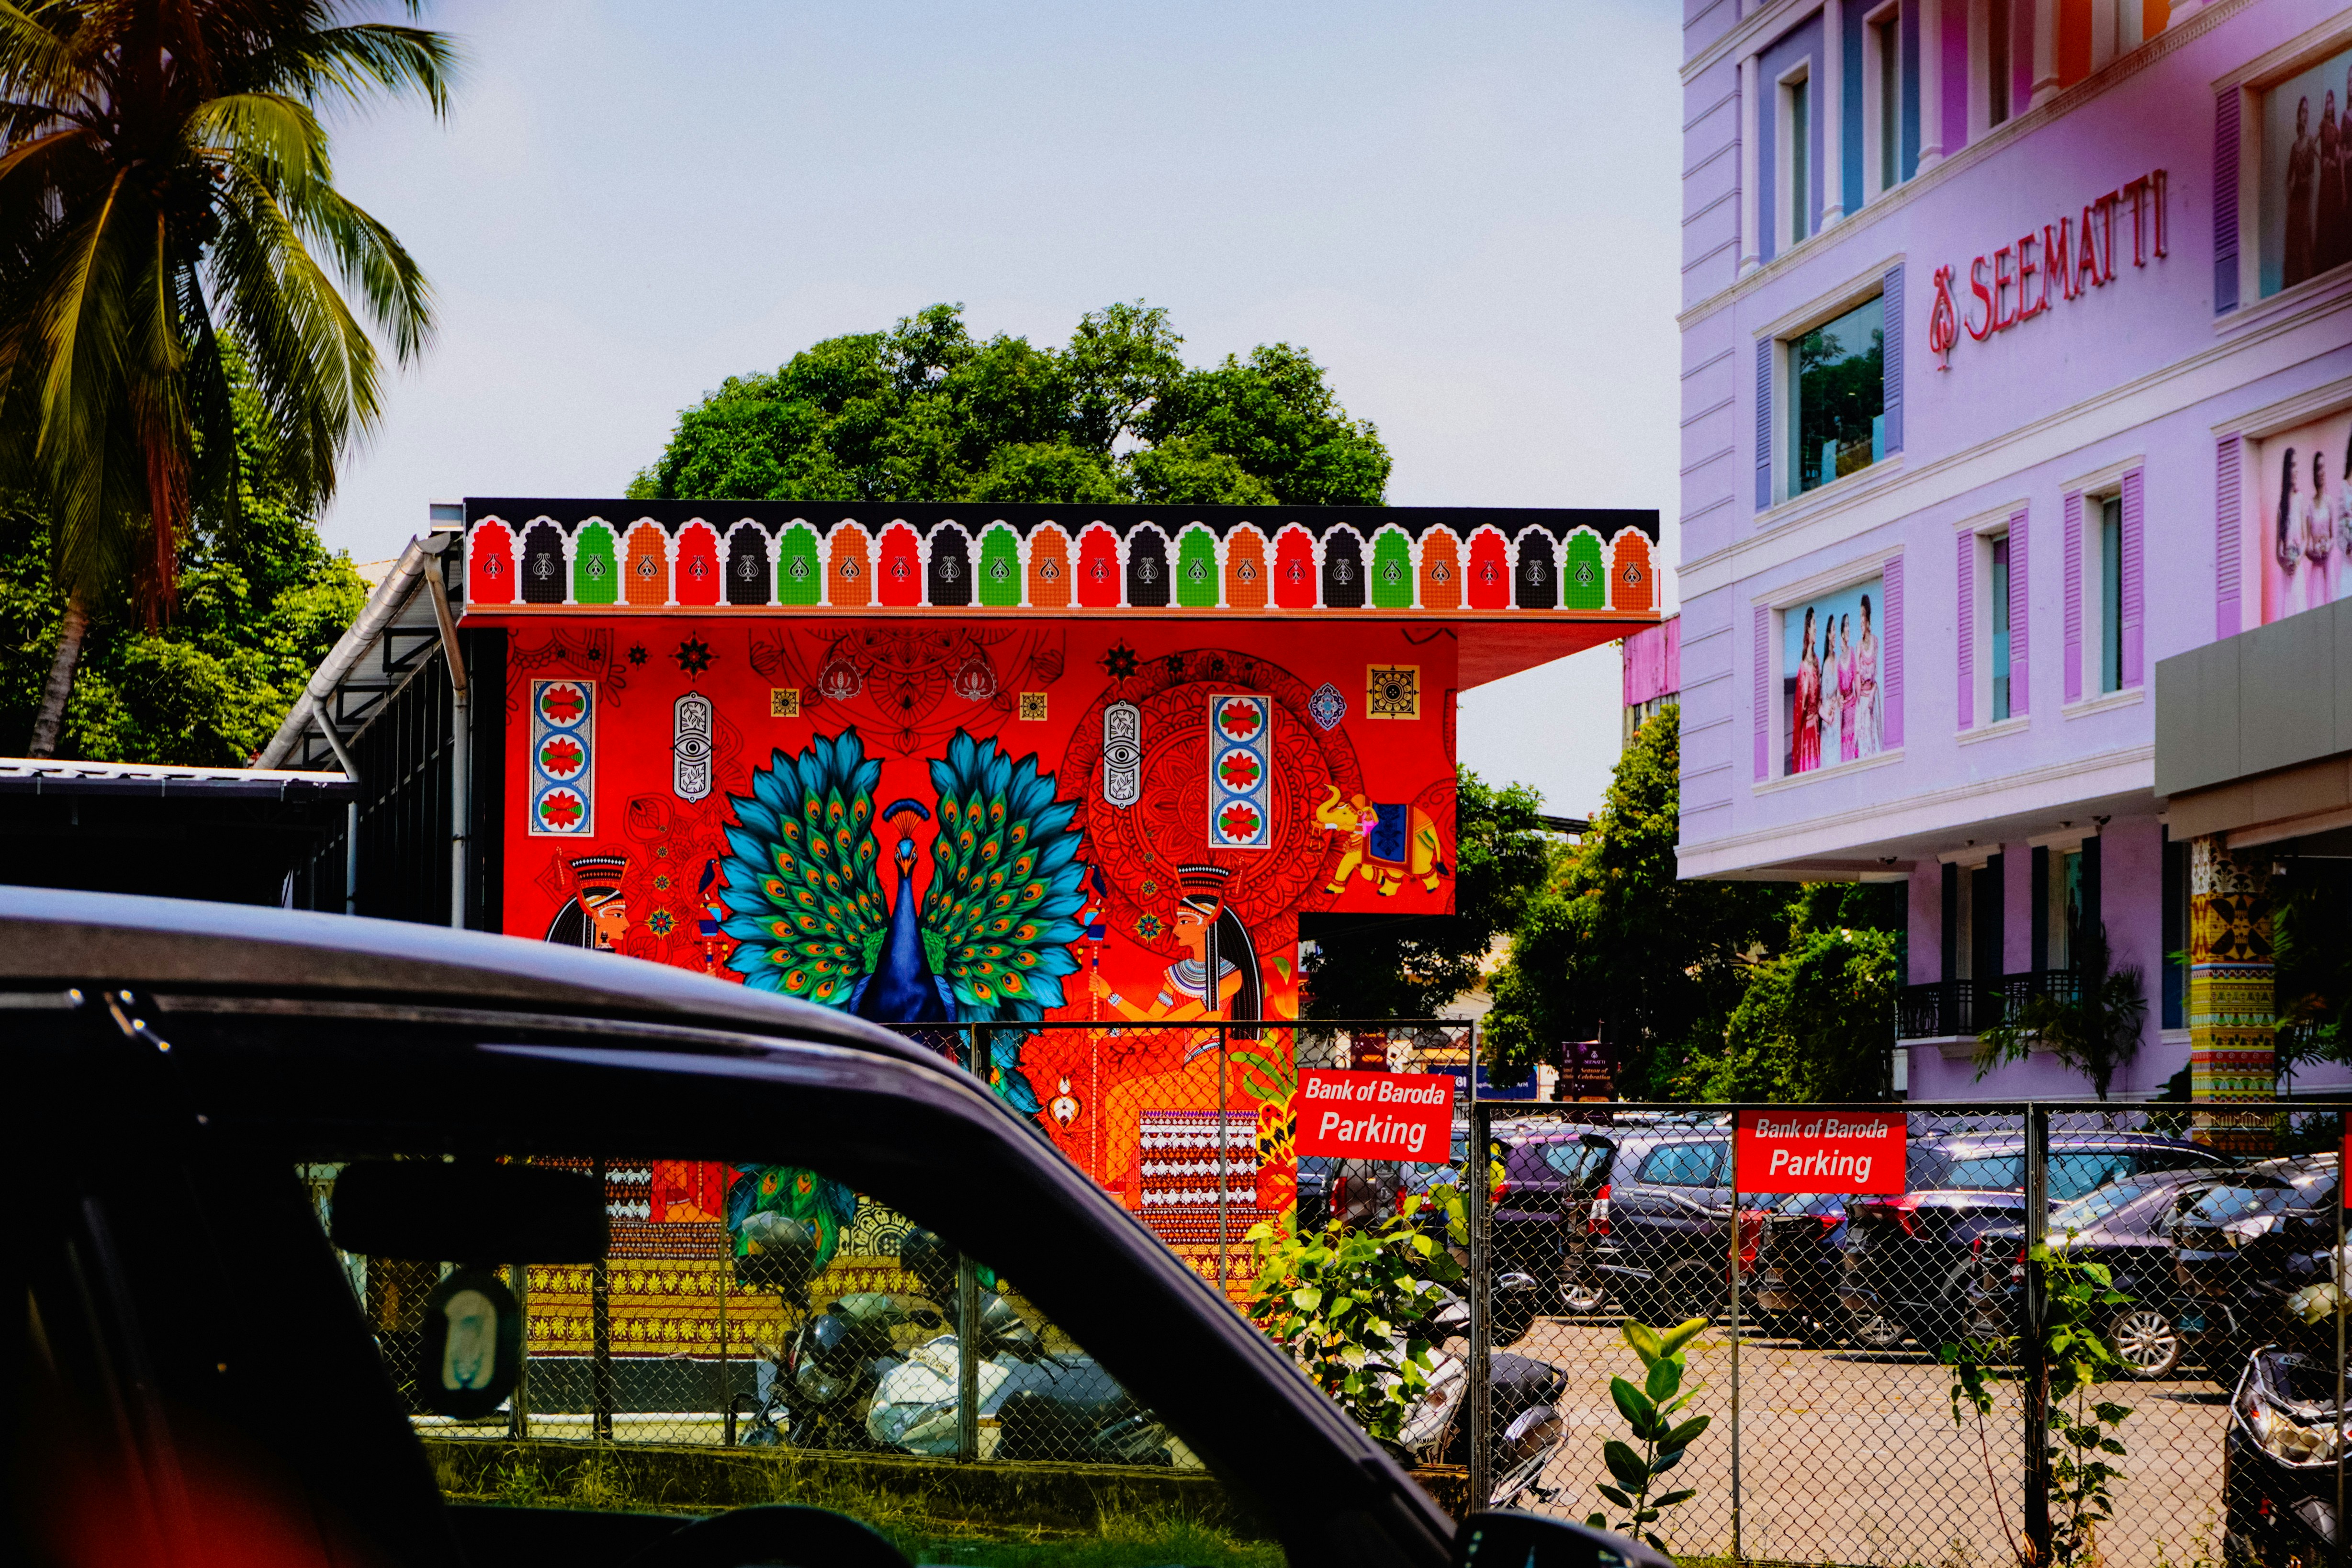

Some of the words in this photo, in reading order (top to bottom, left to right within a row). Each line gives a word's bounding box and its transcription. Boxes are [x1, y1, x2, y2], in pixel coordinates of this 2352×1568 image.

[1964, 169, 2168, 341] SEEMATTI
[1305, 1077, 1355, 1100] Bank
[1356, 1081, 1377, 1101] of
[1377, 1081, 1445, 1105] Baroda
[1318, 1111, 1427, 1153] Parking
[1755, 1119, 1801, 1138] Bank
[1803, 1119, 1823, 1138] of
[1824, 1119, 1888, 1138] Baroda
[1769, 1149, 1872, 1183] Parking
